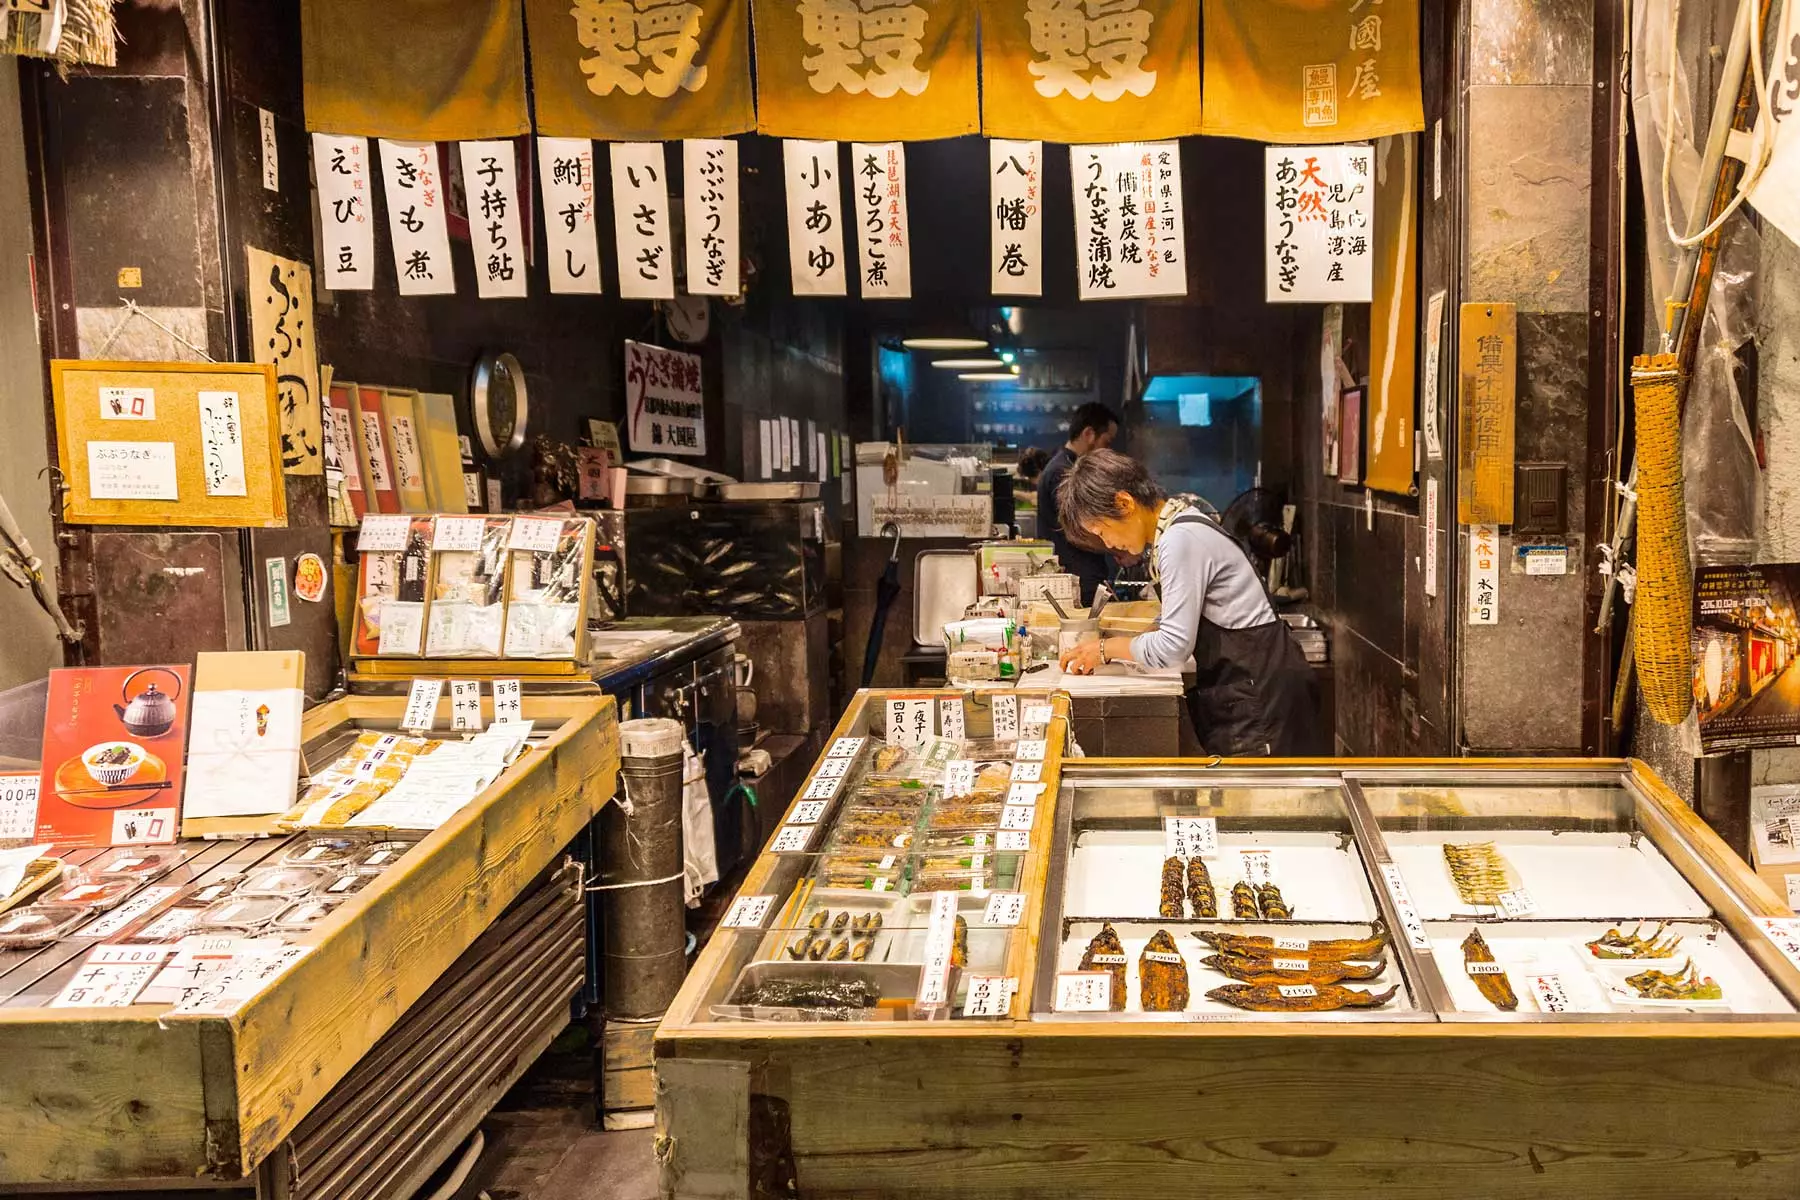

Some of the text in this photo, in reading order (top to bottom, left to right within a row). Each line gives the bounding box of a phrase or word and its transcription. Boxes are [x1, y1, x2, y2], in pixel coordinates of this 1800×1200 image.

[1346, 0, 1382, 100] 國屋
[330, 148, 358, 274] えび豆
[350, 146, 366, 224] 甘さ控えめ
[395, 157, 434, 281] きも煮
[417, 148, 436, 208] うなぎ
[477, 157, 515, 282] 子持ち鮎
[553, 157, 587, 278] 鮒ずし
[580, 151, 594, 224] ニゴロブナ
[627, 165, 664, 280] いさざ
[700, 150, 726, 287] ぶぶうなぎ
[801, 155, 835, 277] 小あゆ
[860, 153, 889, 287] 本もろこ煮
[886, 149, 903, 248] 琵琶湖産天然
[996, 154, 1029, 276] 八幡巻
[1025, 151, 1037, 216] うなぎの
[1084, 154, 1117, 289] うなぎ蒲焼
[1115, 171, 1143, 264] 備長炭焼
[1158, 151, 1178, 264] 愛知県三河一色
[1275, 156, 1300, 293] あおうなぎ
[1297, 156, 1329, 223] 天然
[1348, 156, 1368, 256] 瀬戸内海
[1327, 183, 1347, 282] 児島湾産
[1475, 525, 1494, 621] 定休日 水曜日
[454, 684, 466, 727] 百十円
[1006, 697, 1017, 731] いさざ
[1172, 819, 1187, 856] 千七百円
[102, 951, 157, 961] 1100
[1279, 941, 1306, 949] 2550
[1471, 965, 1500, 973] 1800
